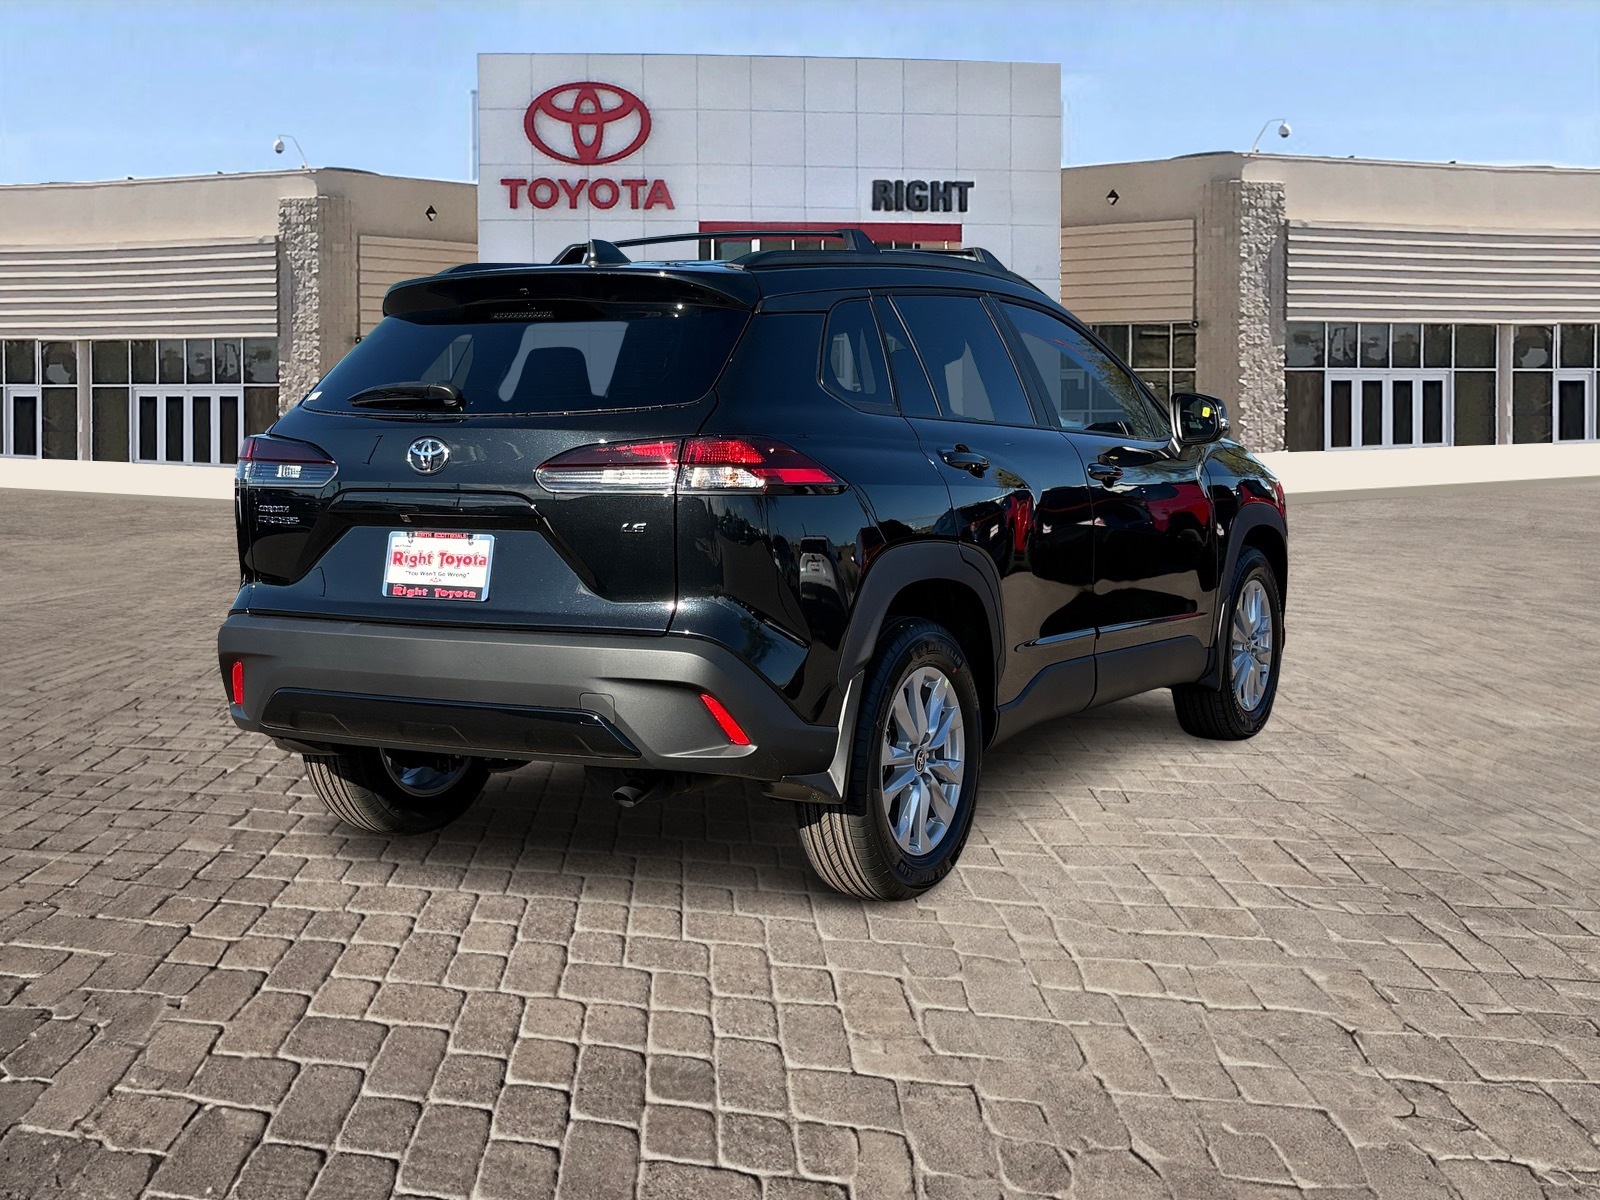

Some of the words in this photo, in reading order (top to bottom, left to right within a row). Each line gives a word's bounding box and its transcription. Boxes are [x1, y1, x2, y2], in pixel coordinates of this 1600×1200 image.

[500, 178, 675, 210] TOYOTA
[872, 179, 975, 212] RIGHT
[621, 522, 647, 533] LE
[392, 551, 433, 568] Right
[439, 551, 488, 569] Toyota
[392, 585, 429, 598] Right
[434, 587, 477, 599] Toyota
